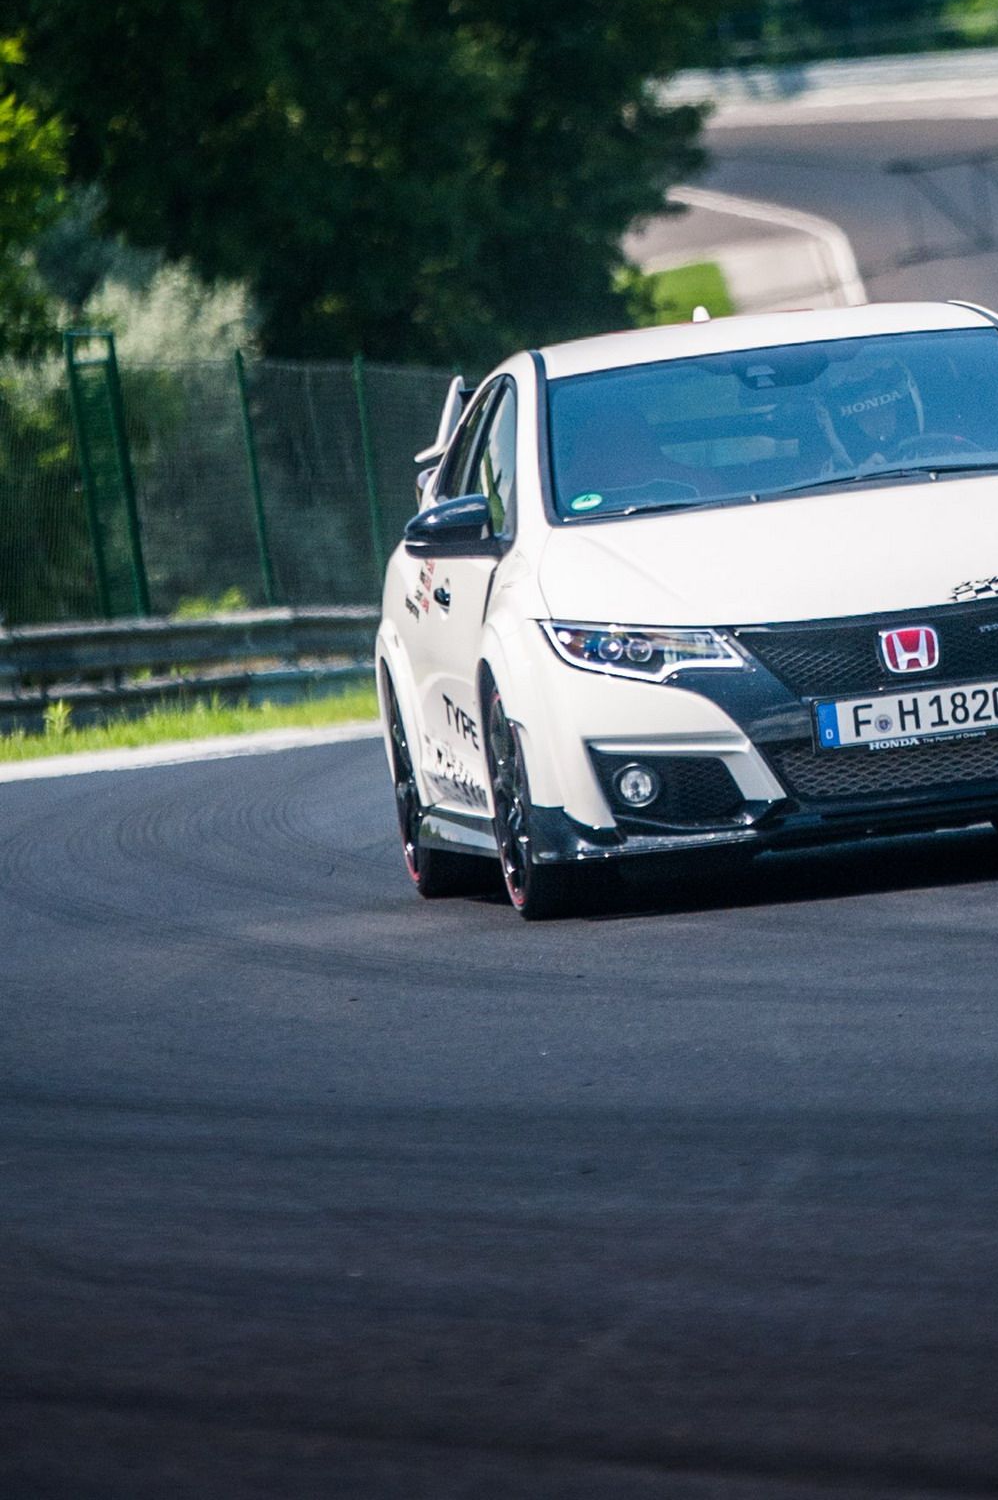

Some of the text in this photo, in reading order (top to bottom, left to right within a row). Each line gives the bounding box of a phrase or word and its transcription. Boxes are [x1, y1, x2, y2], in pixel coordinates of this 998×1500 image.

[841, 390, 901, 416] HONDA
[442, 693, 479, 751] TYPE
[853, 703, 873, 738] F
[868, 738, 920, 750] HONDA
